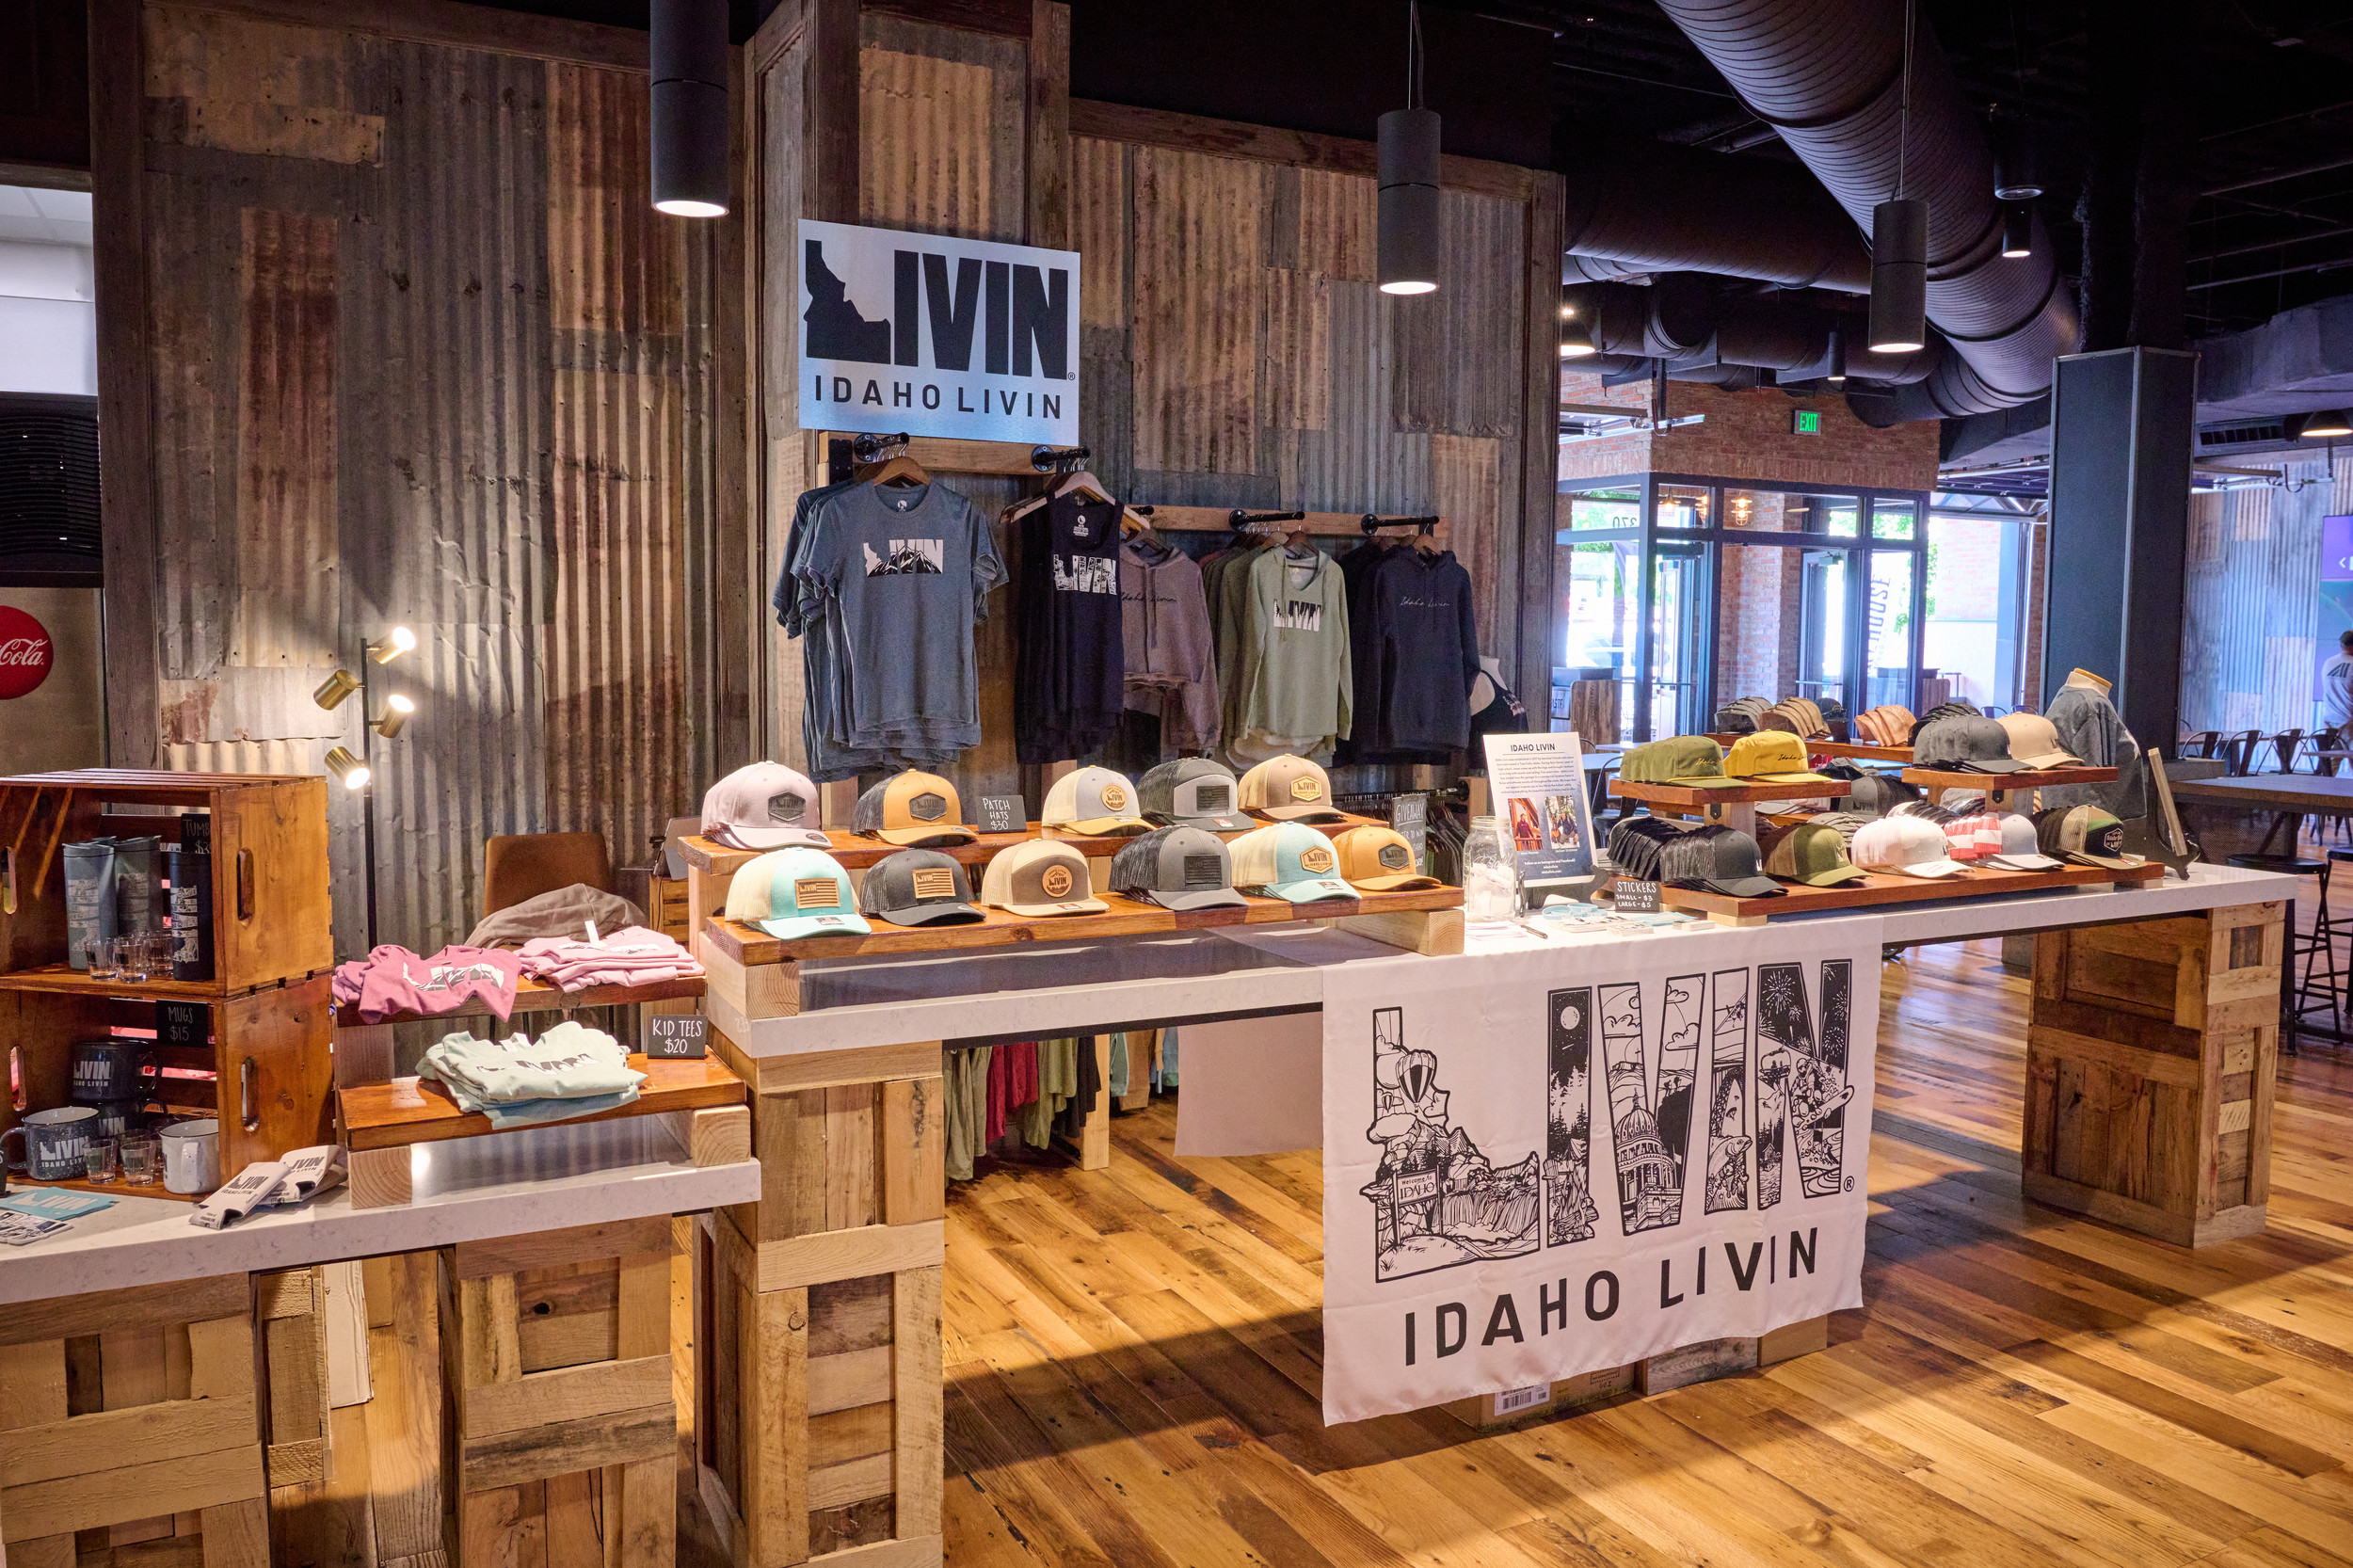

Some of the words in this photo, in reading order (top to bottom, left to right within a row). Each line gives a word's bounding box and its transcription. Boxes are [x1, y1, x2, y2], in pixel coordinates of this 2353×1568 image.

[814, 375, 941, 409] IDAHO
[957, 387, 1061, 420] LIVIN
[1800, 412, 1818, 432] EXIT
[1510, 744, 1534, 753] IDAHO
[1536, 743, 1556, 752] LIVIN
[983, 797, 1011, 810] PATCH
[1396, 802, 1424, 822] GIVEAWAY
[989, 811, 1009, 821] HATS
[990, 820, 1009, 830] $30
[1616, 881, 1657, 894] STICKERS
[168, 1006, 194, 1024] MUGS
[169, 1025, 190, 1042] $15
[652, 1018, 675, 1036] KID
[678, 1020, 703, 1037] TEES
[664, 1037, 688, 1054] $20
[98, 1116, 125, 1137] VIN
[41, 1160, 66, 1169] IDAHO
[1400, 1181, 1435, 1200] IDAHO
[1406, 1270, 1620, 1367] IDAHO
[1660, 1227, 1817, 1309] LIVIN
